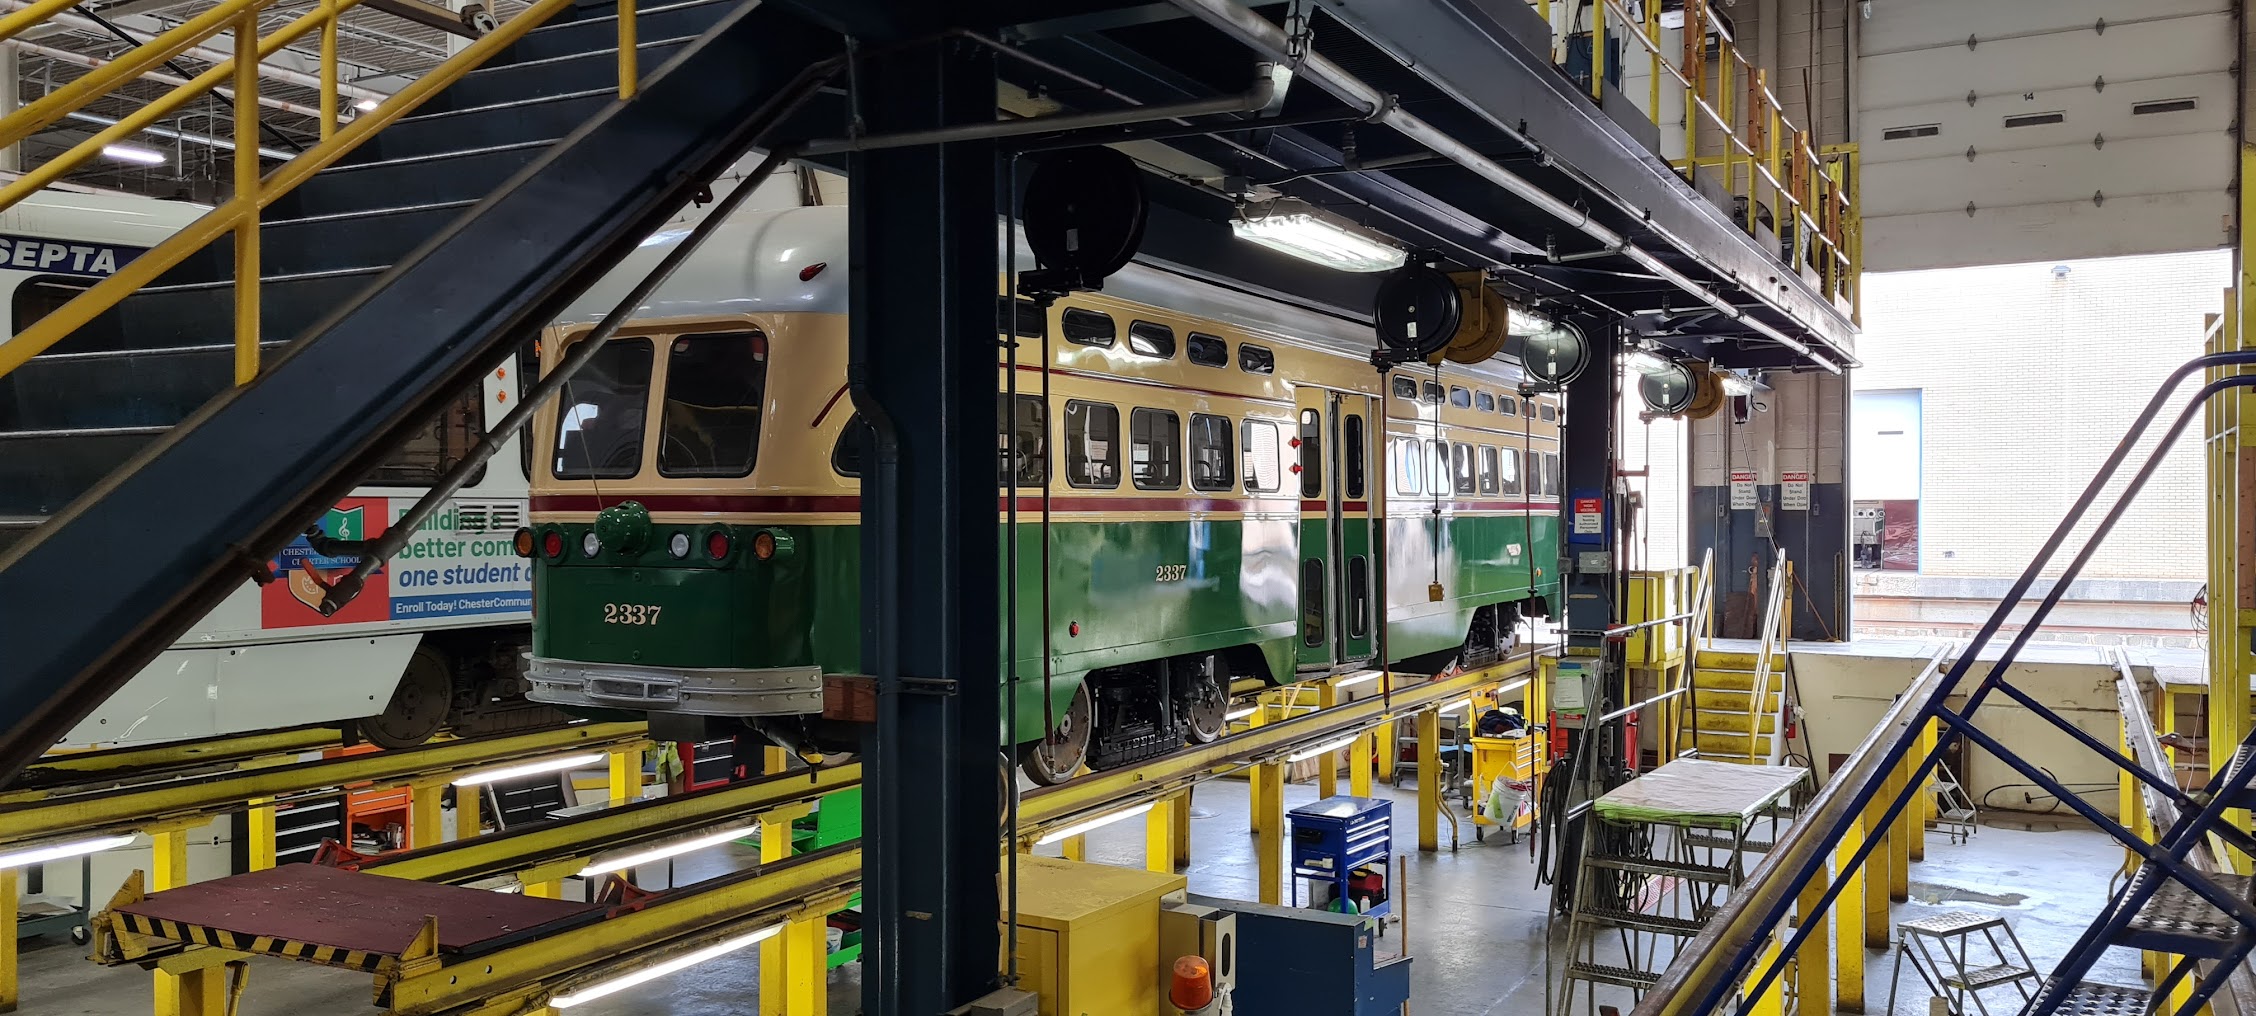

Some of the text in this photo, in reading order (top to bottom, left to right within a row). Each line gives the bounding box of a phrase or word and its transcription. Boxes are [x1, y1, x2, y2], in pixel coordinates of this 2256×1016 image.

[398, 537, 516, 560] better com
[399, 568, 439, 588] one
[442, 562, 521, 585] student
[1155, 564, 1187, 582] 2337
[395, 601, 424, 613] Enroll
[425, 599, 457, 613] Today!
[604, 602, 662, 626] 2337
